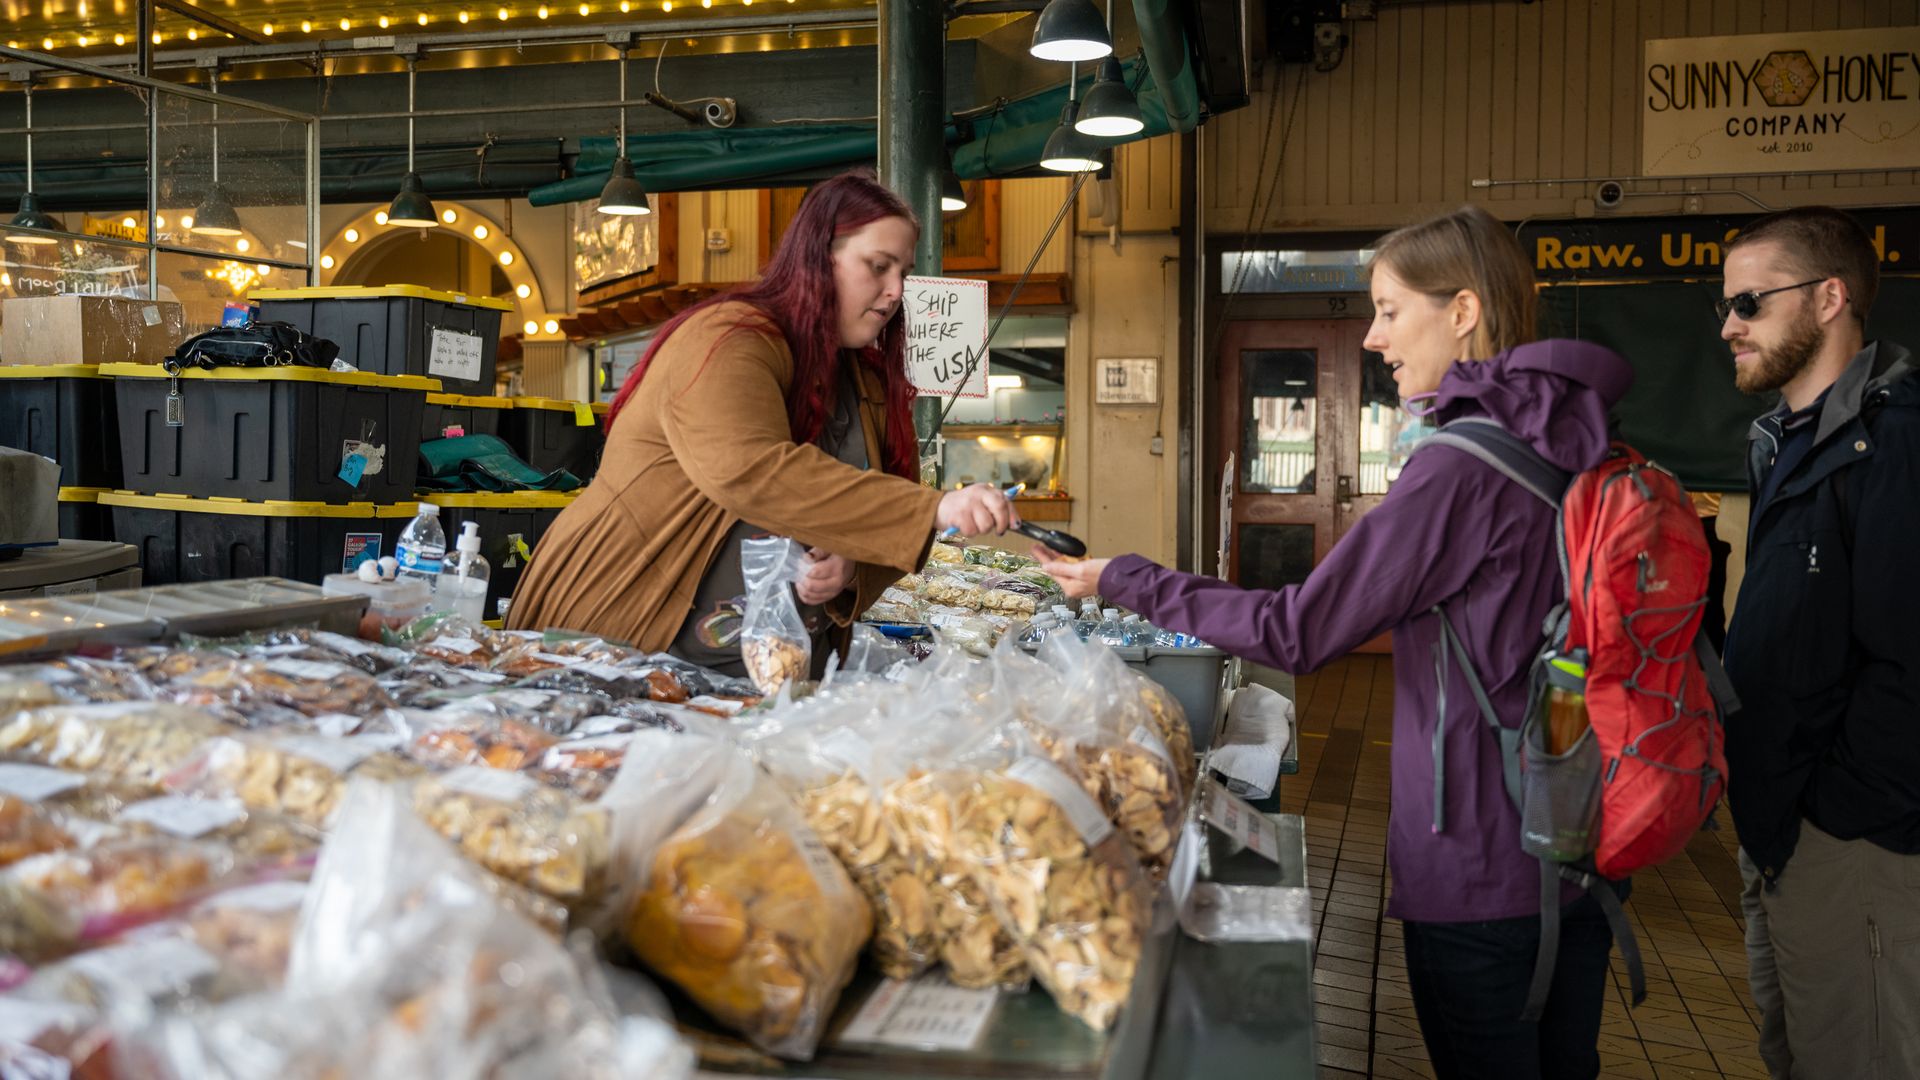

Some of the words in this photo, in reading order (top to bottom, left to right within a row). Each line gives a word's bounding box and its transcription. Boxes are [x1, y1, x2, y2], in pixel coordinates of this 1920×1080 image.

[1648, 58, 1761, 112] SUNNY
[1726, 112, 1846, 137] COMPANY
[1786, 142, 1813, 153] 2010
[1537, 237, 1644, 270] Raw.
[1328, 297, 1347, 312] 93
[906, 344, 936, 363] THE
